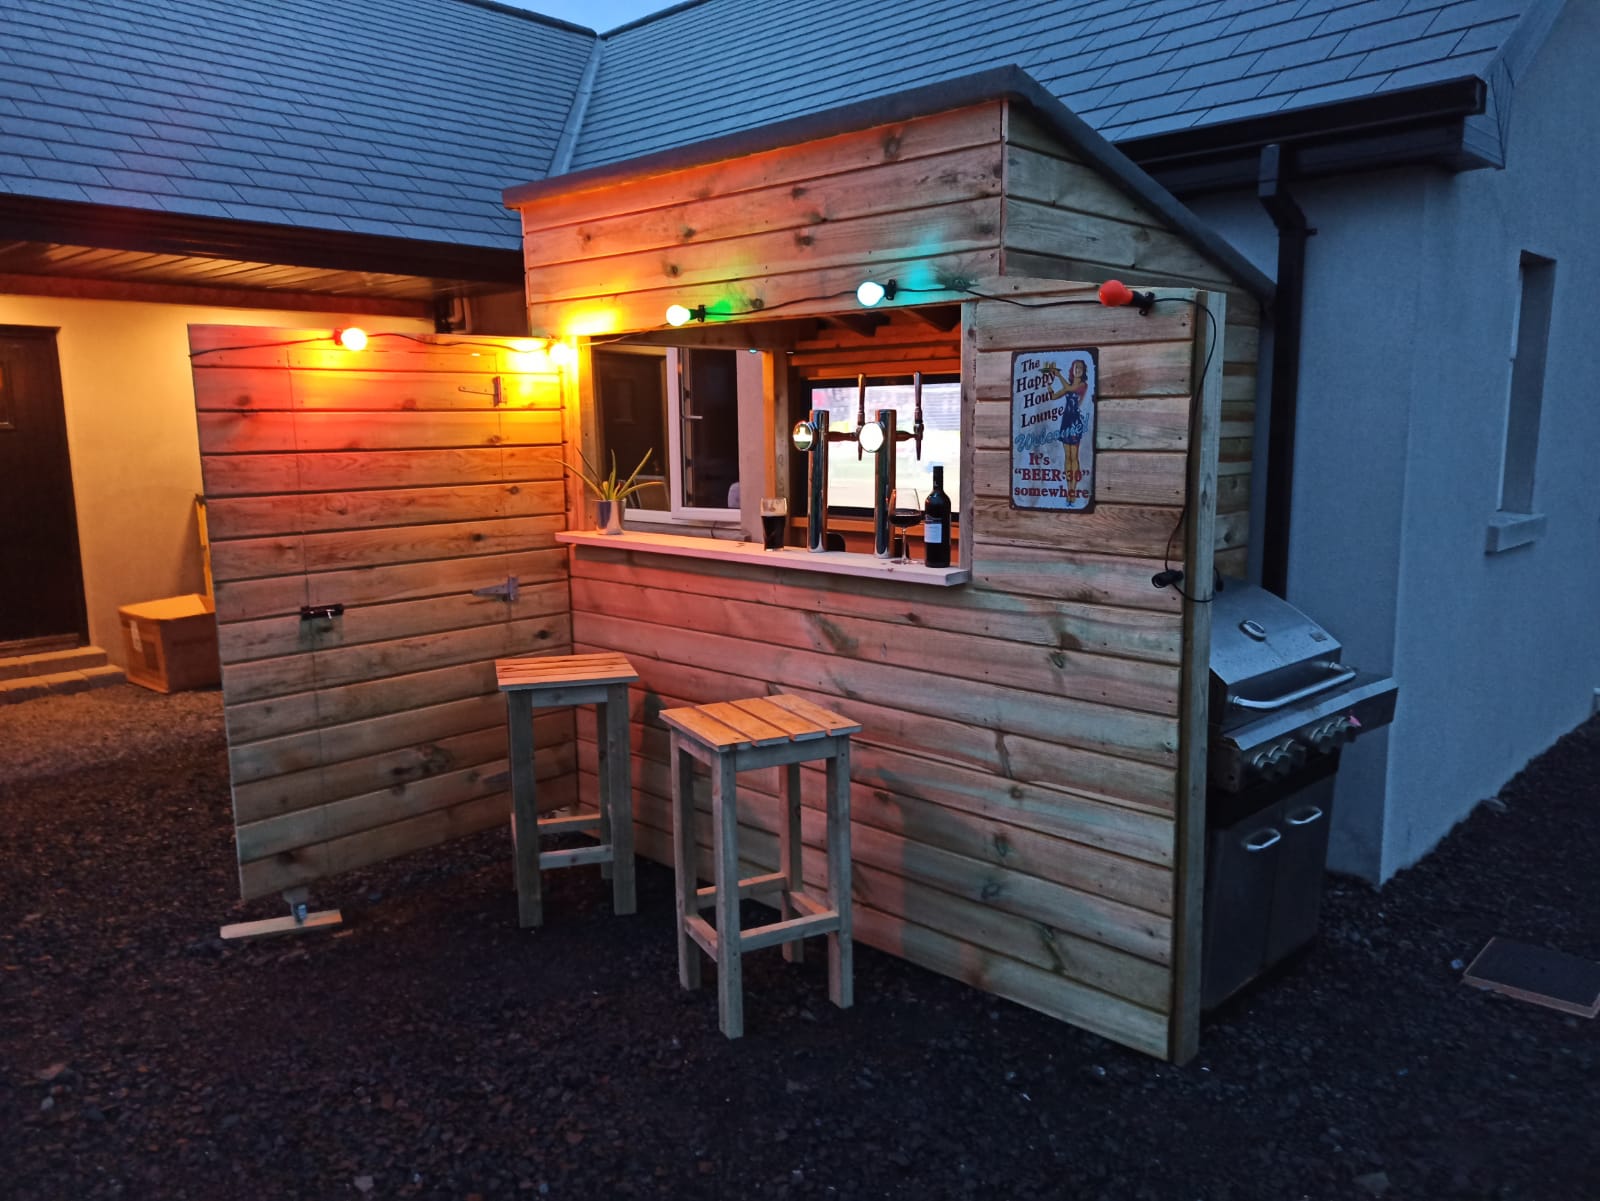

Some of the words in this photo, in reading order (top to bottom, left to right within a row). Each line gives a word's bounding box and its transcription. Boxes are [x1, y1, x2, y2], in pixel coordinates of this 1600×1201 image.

[1021, 359, 1040, 373] The
[1016, 370, 1056, 393] Happy
[1024, 390, 1054, 409] Hour
[1021, 405, 1064, 428] Lounge
[1029, 453, 1050, 465] It's
[1014, 486, 1089, 499] somewhere
